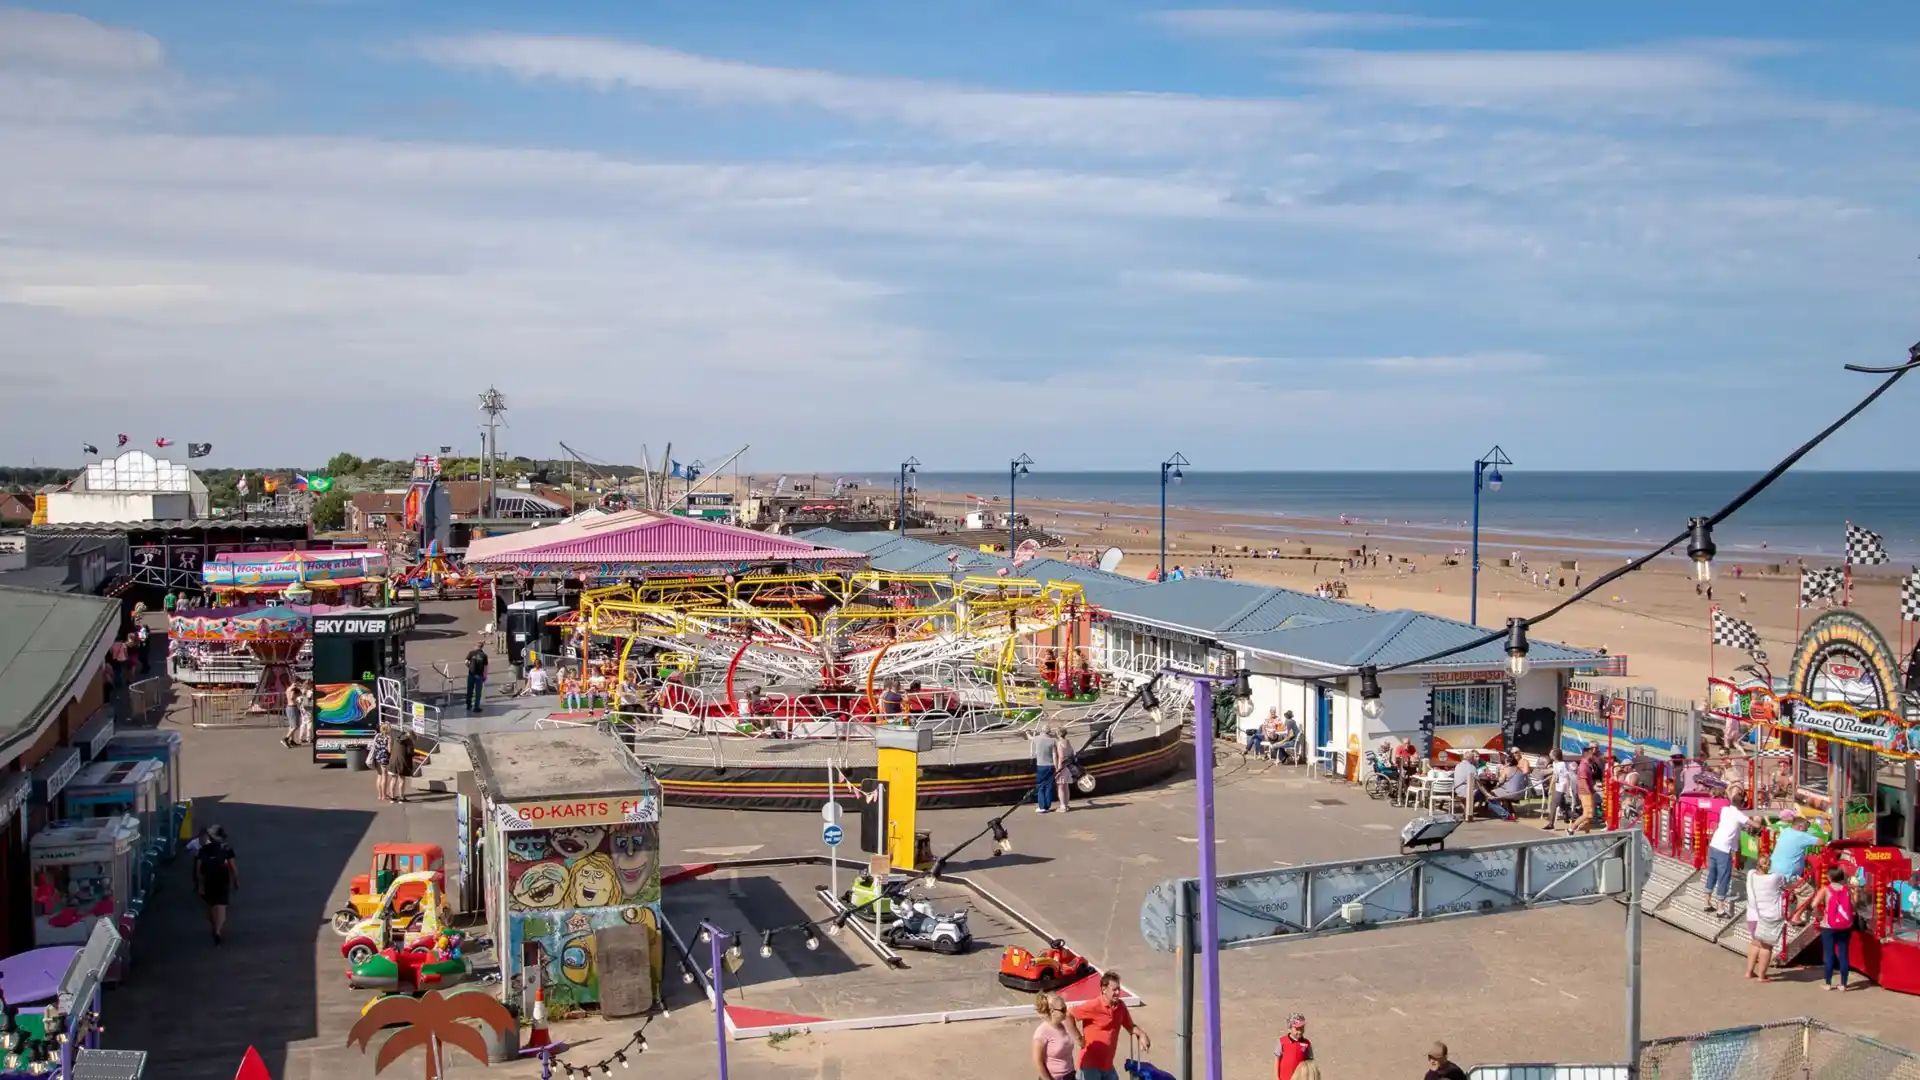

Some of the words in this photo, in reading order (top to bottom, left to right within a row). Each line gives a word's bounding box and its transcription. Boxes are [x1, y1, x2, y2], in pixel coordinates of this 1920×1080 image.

[237, 564, 263, 573] Hook
[307, 561, 332, 570] Hook
[314, 620, 344, 633] SKY
[345, 620, 386, 633] DIVER
[1831, 665, 1858, 676] Cars
[518, 803, 608, 820] GO-KARTS
[621, 801, 639, 814] £1
[1546, 859, 1579, 870] SKYBOND
[1474, 867, 1508, 878] SKYBOND
[1254, 901, 1289, 913] KYBOND
[1436, 900, 1472, 912] SKYBOND
